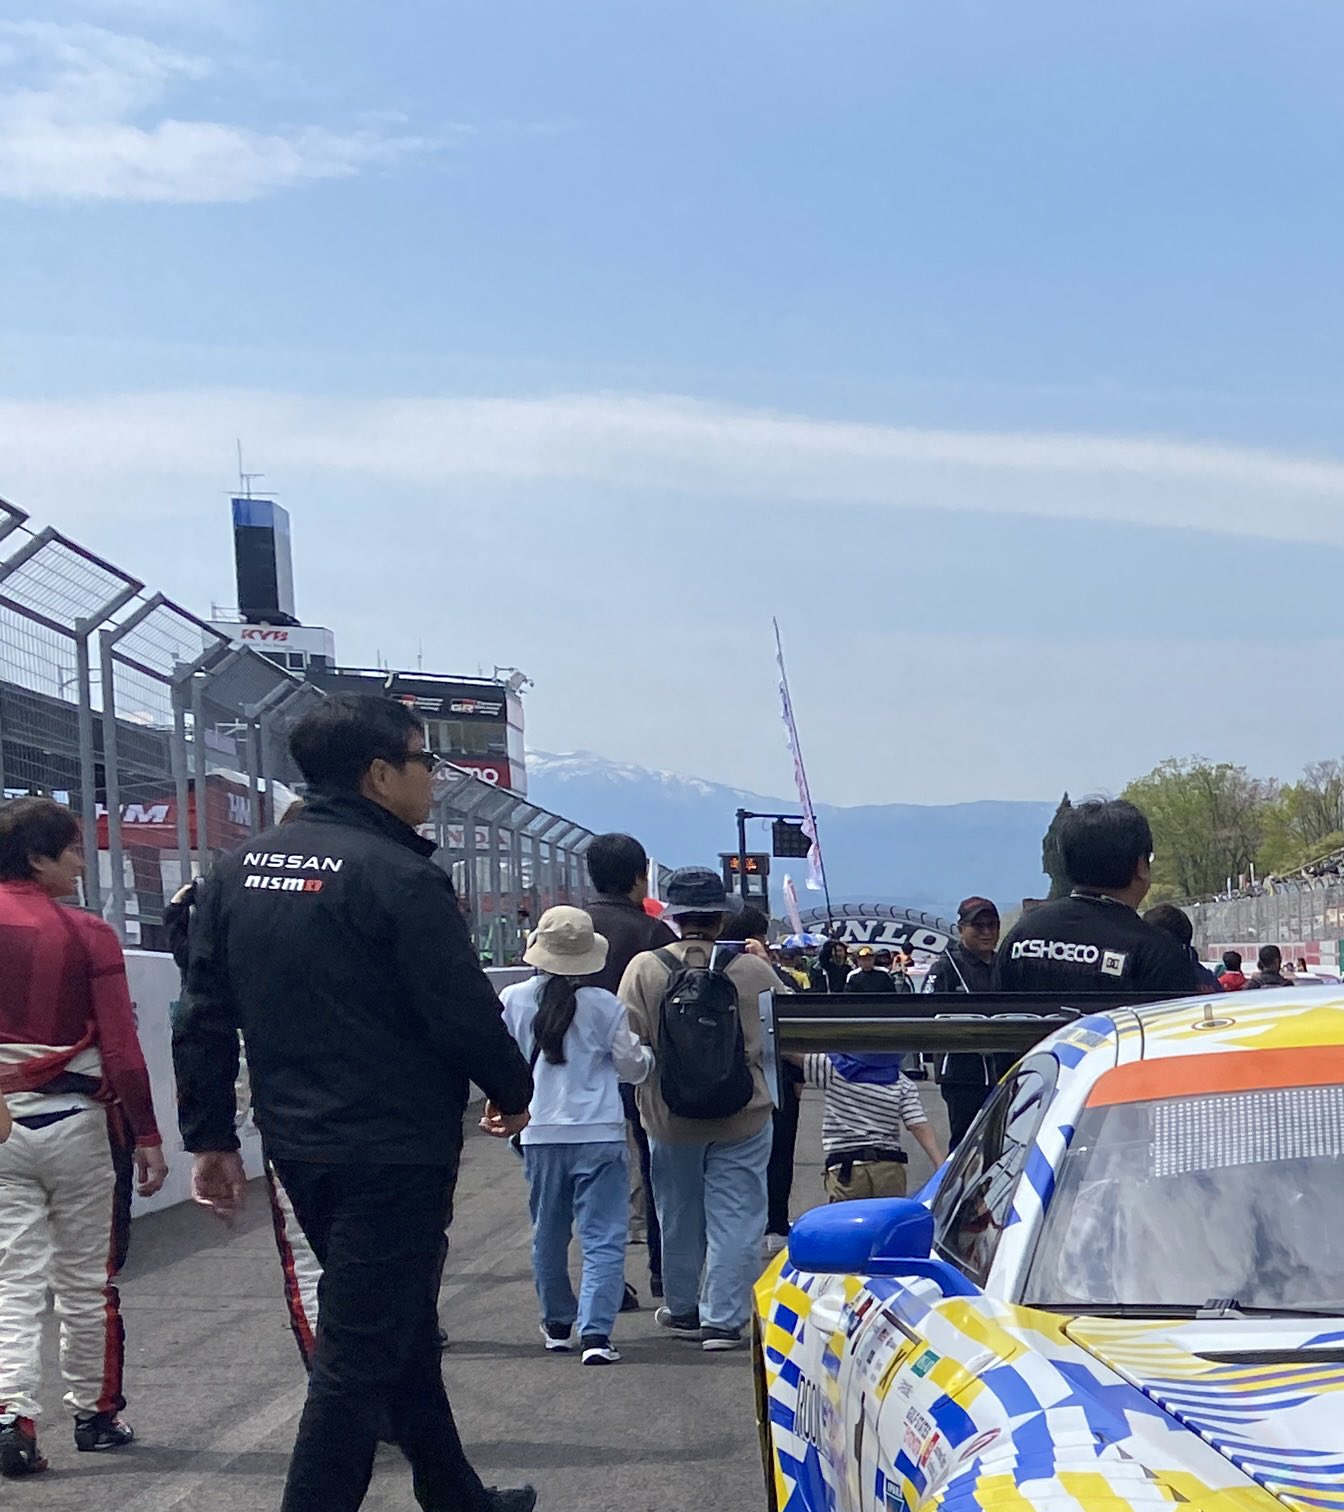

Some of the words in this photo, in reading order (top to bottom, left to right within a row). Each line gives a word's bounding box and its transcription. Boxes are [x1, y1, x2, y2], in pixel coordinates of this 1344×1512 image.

[241, 628, 289, 642] KYB
[243, 852, 343, 873] NISSAN
[806, 919, 950, 954] UNLO
